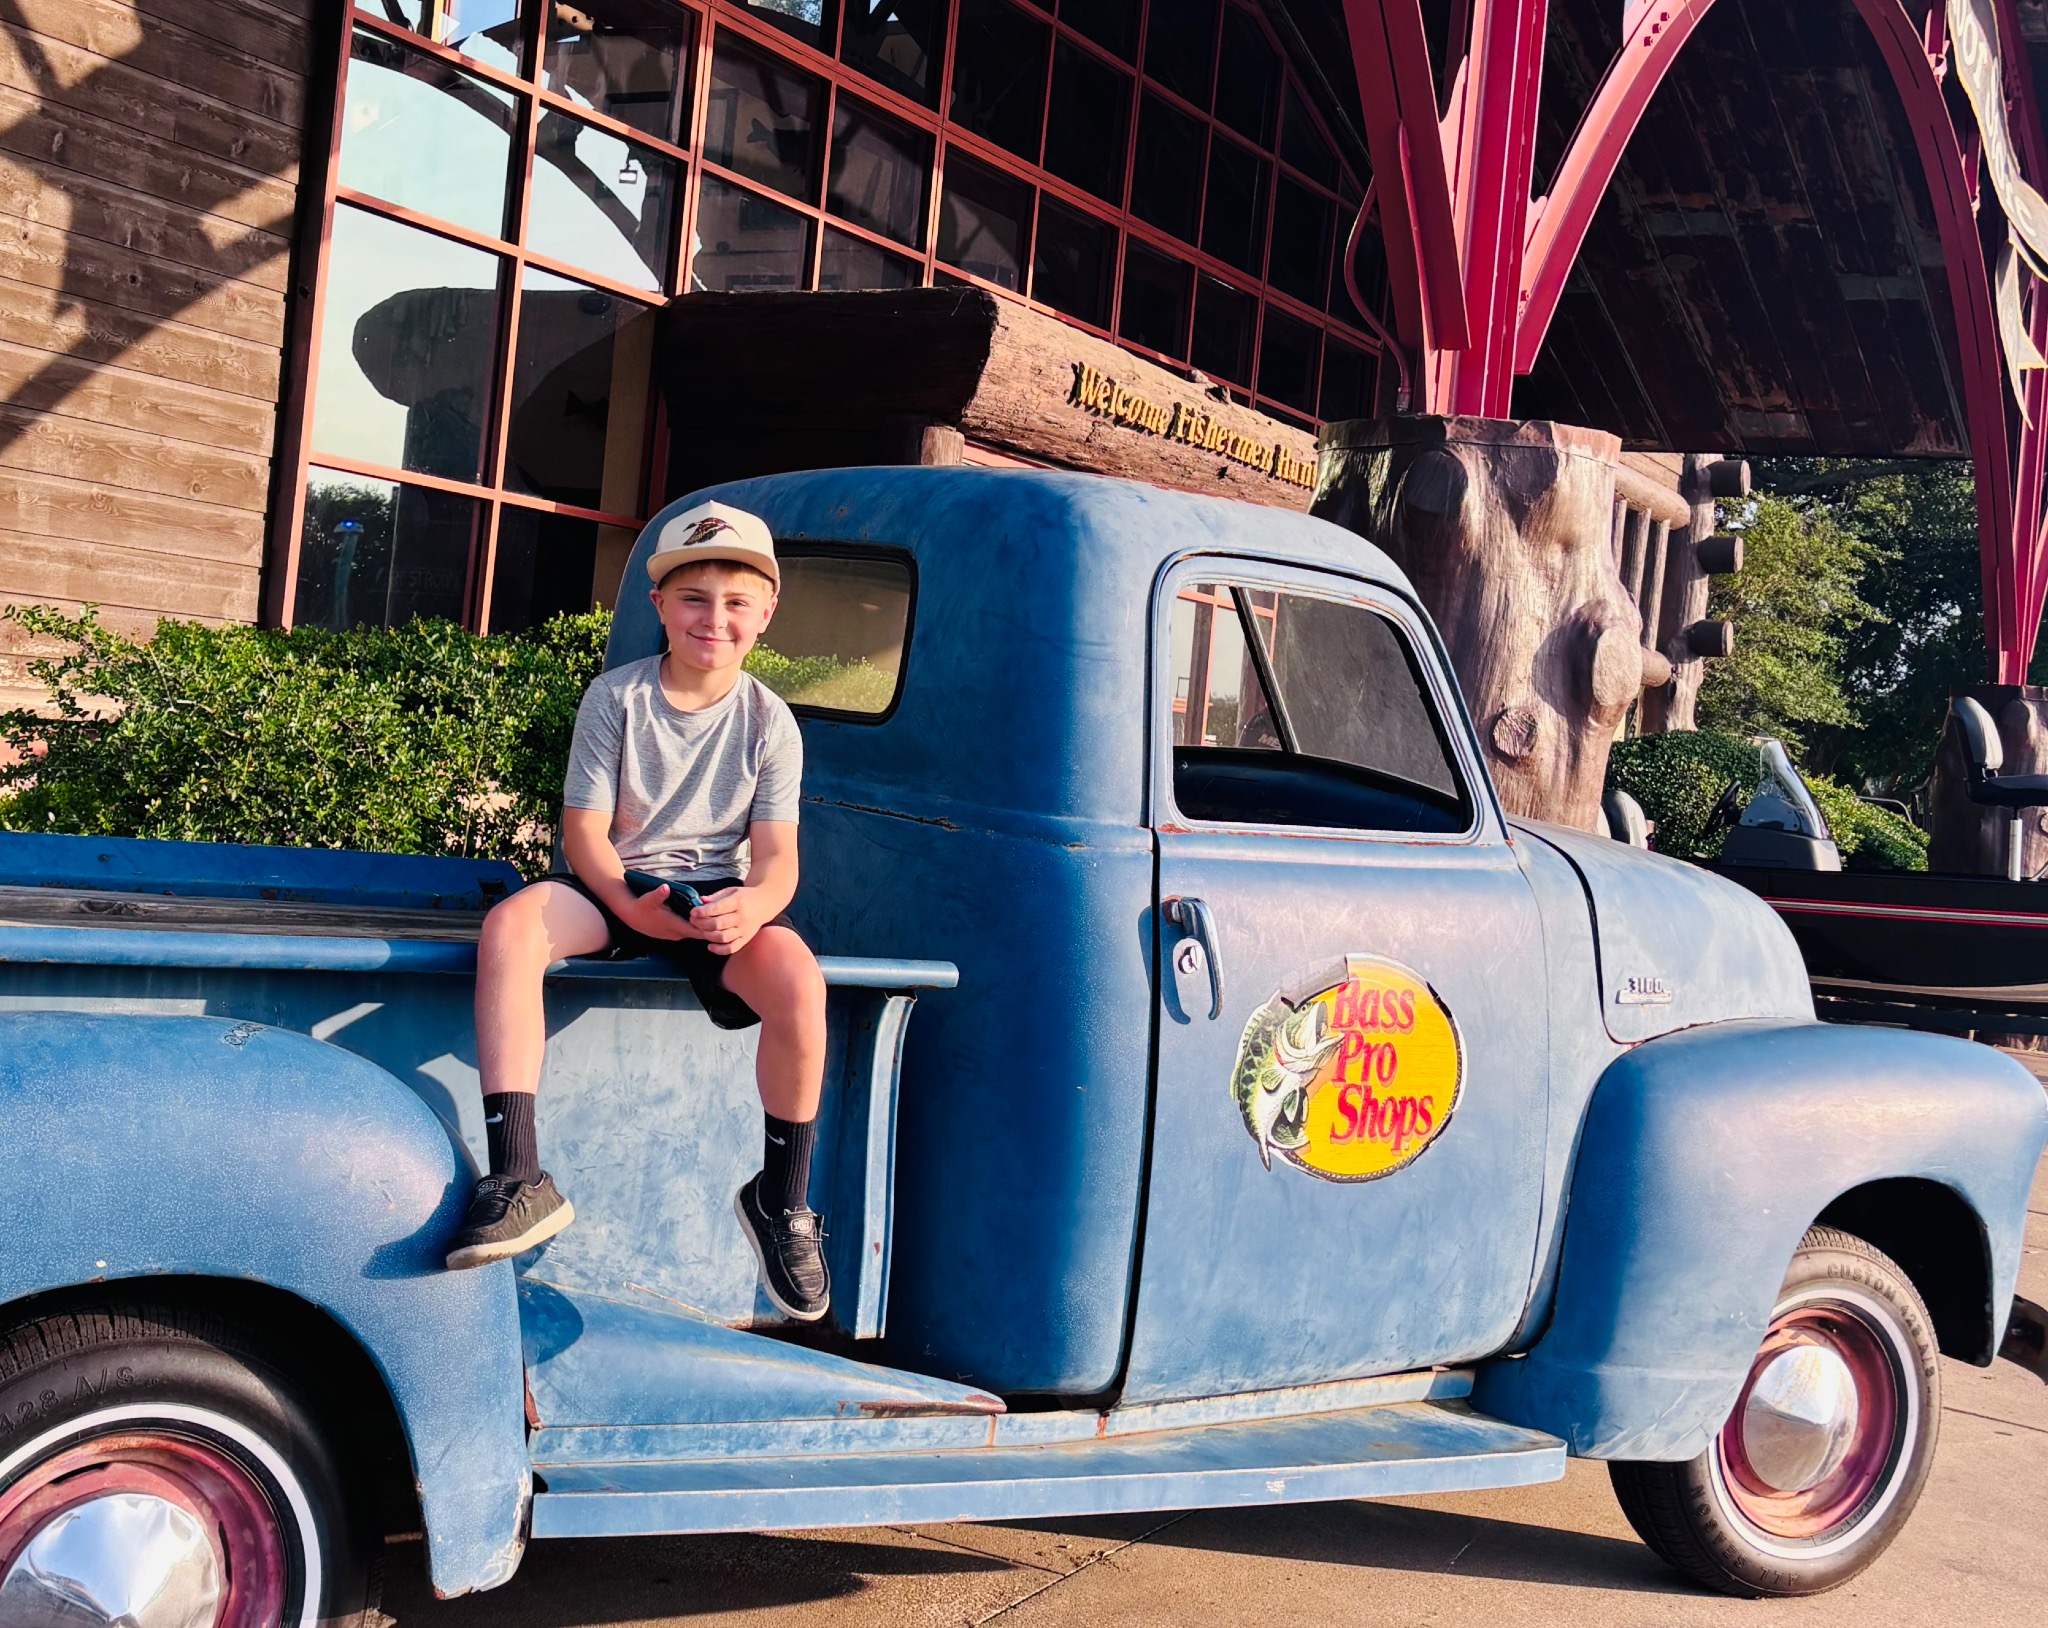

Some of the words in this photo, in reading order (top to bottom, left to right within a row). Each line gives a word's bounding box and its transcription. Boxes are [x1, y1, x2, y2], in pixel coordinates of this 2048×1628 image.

[1077, 362, 1170, 435] Welcome
[1176, 403, 1273, 472] Fishermen
[1331, 974, 1415, 1032] Bass
[1331, 1030, 1397, 1084] Pro
[1331, 1084, 1434, 1152] Shops
[1828, 1263, 1896, 1302] CUSTOM
[73, 1366, 135, 1400] A/S
[1689, 1484, 1748, 1568] SEASON
[1759, 1566, 1800, 1586] ALL
